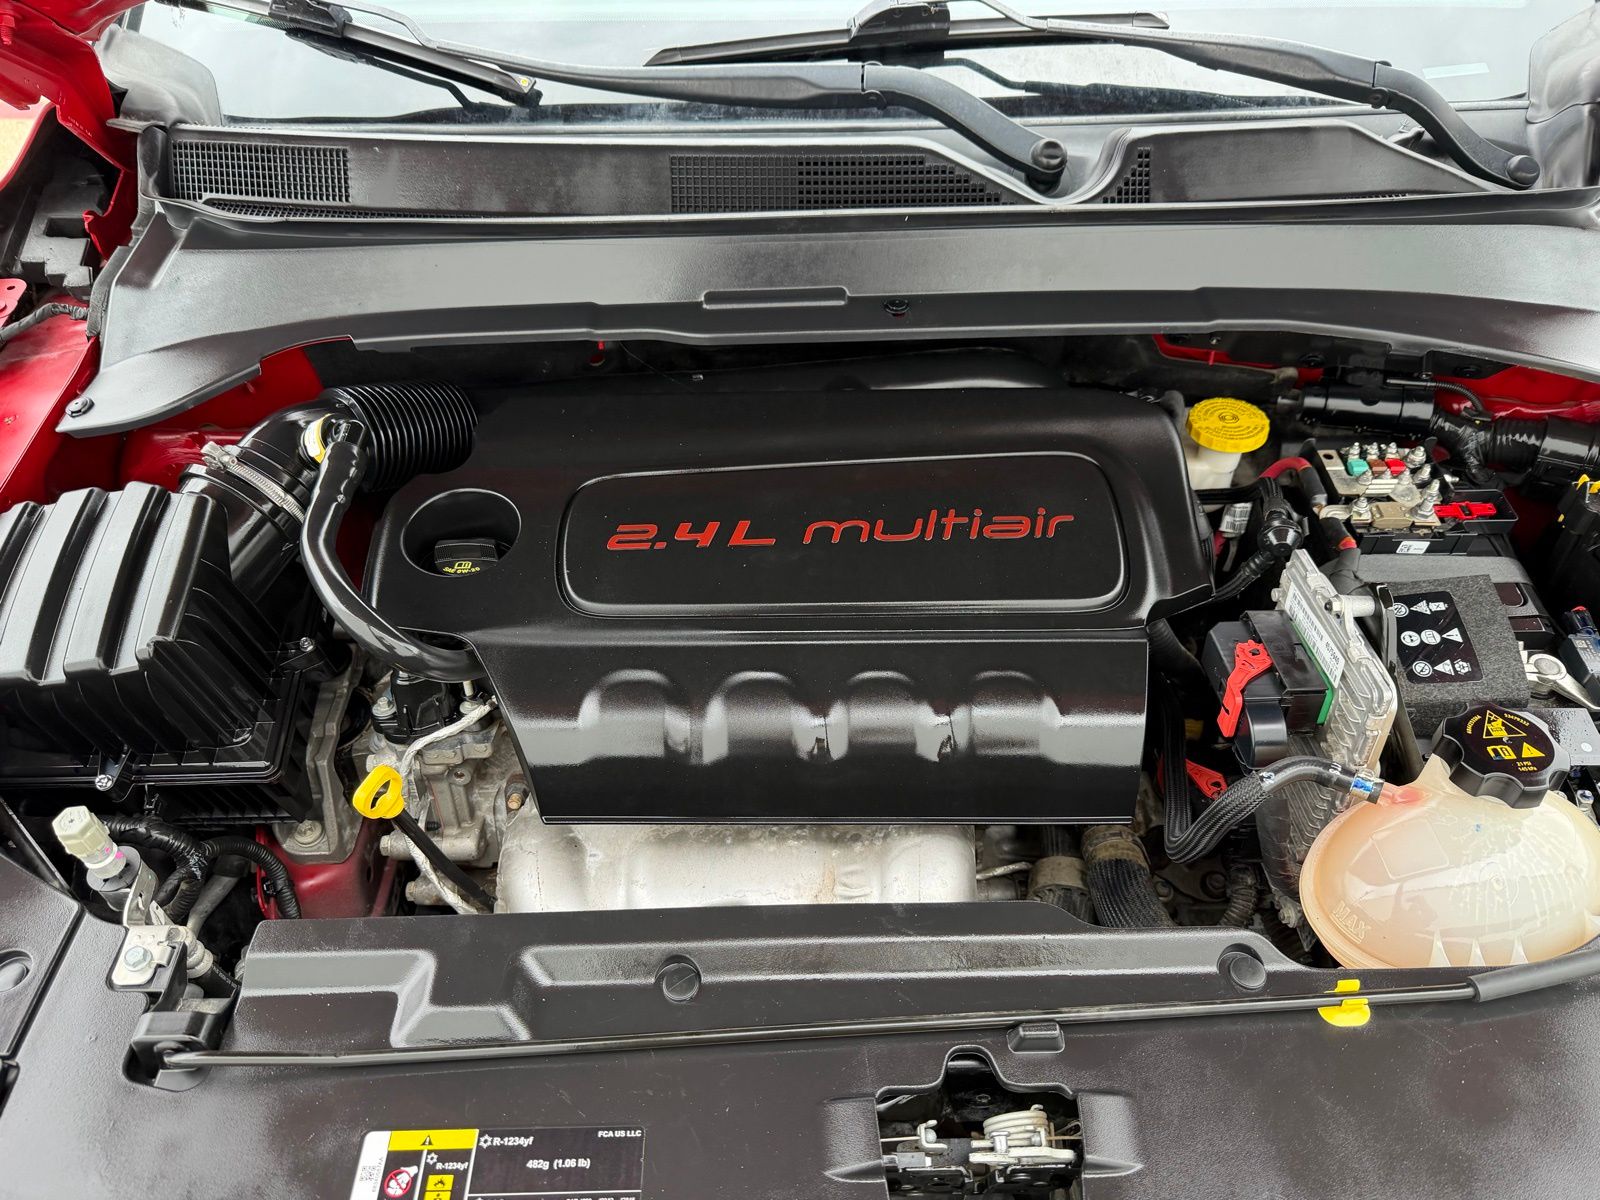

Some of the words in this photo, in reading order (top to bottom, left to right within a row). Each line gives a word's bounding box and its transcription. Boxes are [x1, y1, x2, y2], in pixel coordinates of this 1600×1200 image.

[802, 508, 1074, 544] multiair
[1332, 901, 1371, 940] MAX
[598, 1130, 613, 1138] FCA
[627, 1129, 642, 1137] LLC
[493, 1136, 534, 1147] R-1234yf
[436, 1161, 469, 1171] R-1234yf
[526, 1159, 549, 1170] 482g
[553, 1158, 576, 1169] (1.06
[577, 1158, 590, 1169] lb)
